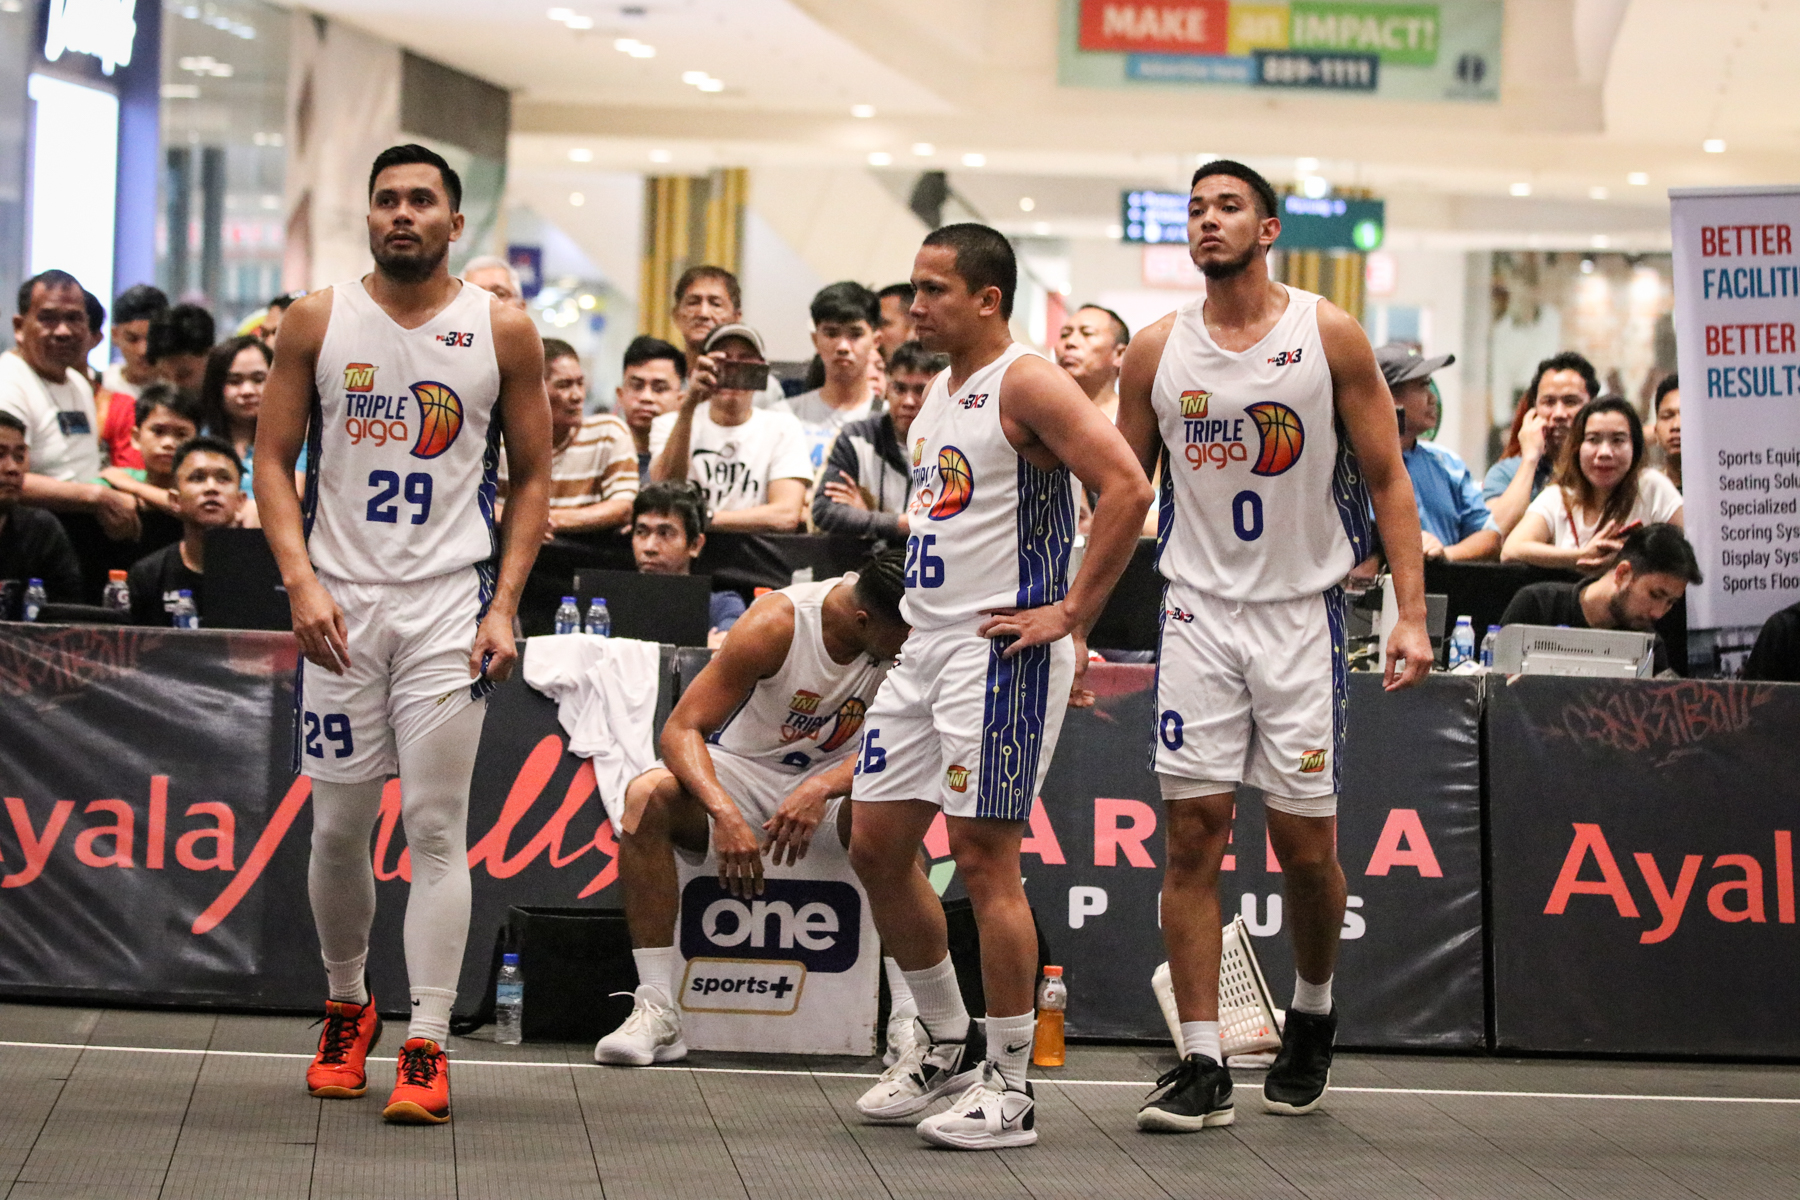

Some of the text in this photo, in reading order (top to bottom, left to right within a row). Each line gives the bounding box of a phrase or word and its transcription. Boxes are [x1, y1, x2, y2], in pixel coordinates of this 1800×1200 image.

[1102, 4, 1207, 43] MAKE
[1293, 13, 1435, 50] IMPACT!
[1701, 224, 1792, 257] BETTER
[1705, 322, 1796, 356] BETTER
[343, 366, 379, 390] TNT
[1707, 365, 1800, 399] RESULT
[346, 394, 408, 420] TRIPLE
[1179, 392, 1212, 417] TNT
[345, 418, 408, 447] giga
[1184, 418, 1244, 443] TRIPLE
[1185, 442, 1248, 471] giga
[1718, 449, 1762, 469] Sports
[366, 469, 433, 525] 29
[1719, 474, 1770, 493] Seating
[1232, 490, 1263, 542] 0
[1720, 498, 1797, 519] Specialized
[1721, 524, 1772, 544] Scoring
[904, 534, 945, 589] 26
[1722, 547, 1800, 569] Display Sys
[1722, 575, 1767, 594] Sports
[304, 711, 354, 759] 29
[1160, 709, 1184, 751] 0
[1299, 749, 1328, 772] TNT
[947, 769, 972, 788] TNT
[0, 775, 237, 889] yala
[702, 898, 840, 951] one
[1068, 885, 1366, 940] PUS
